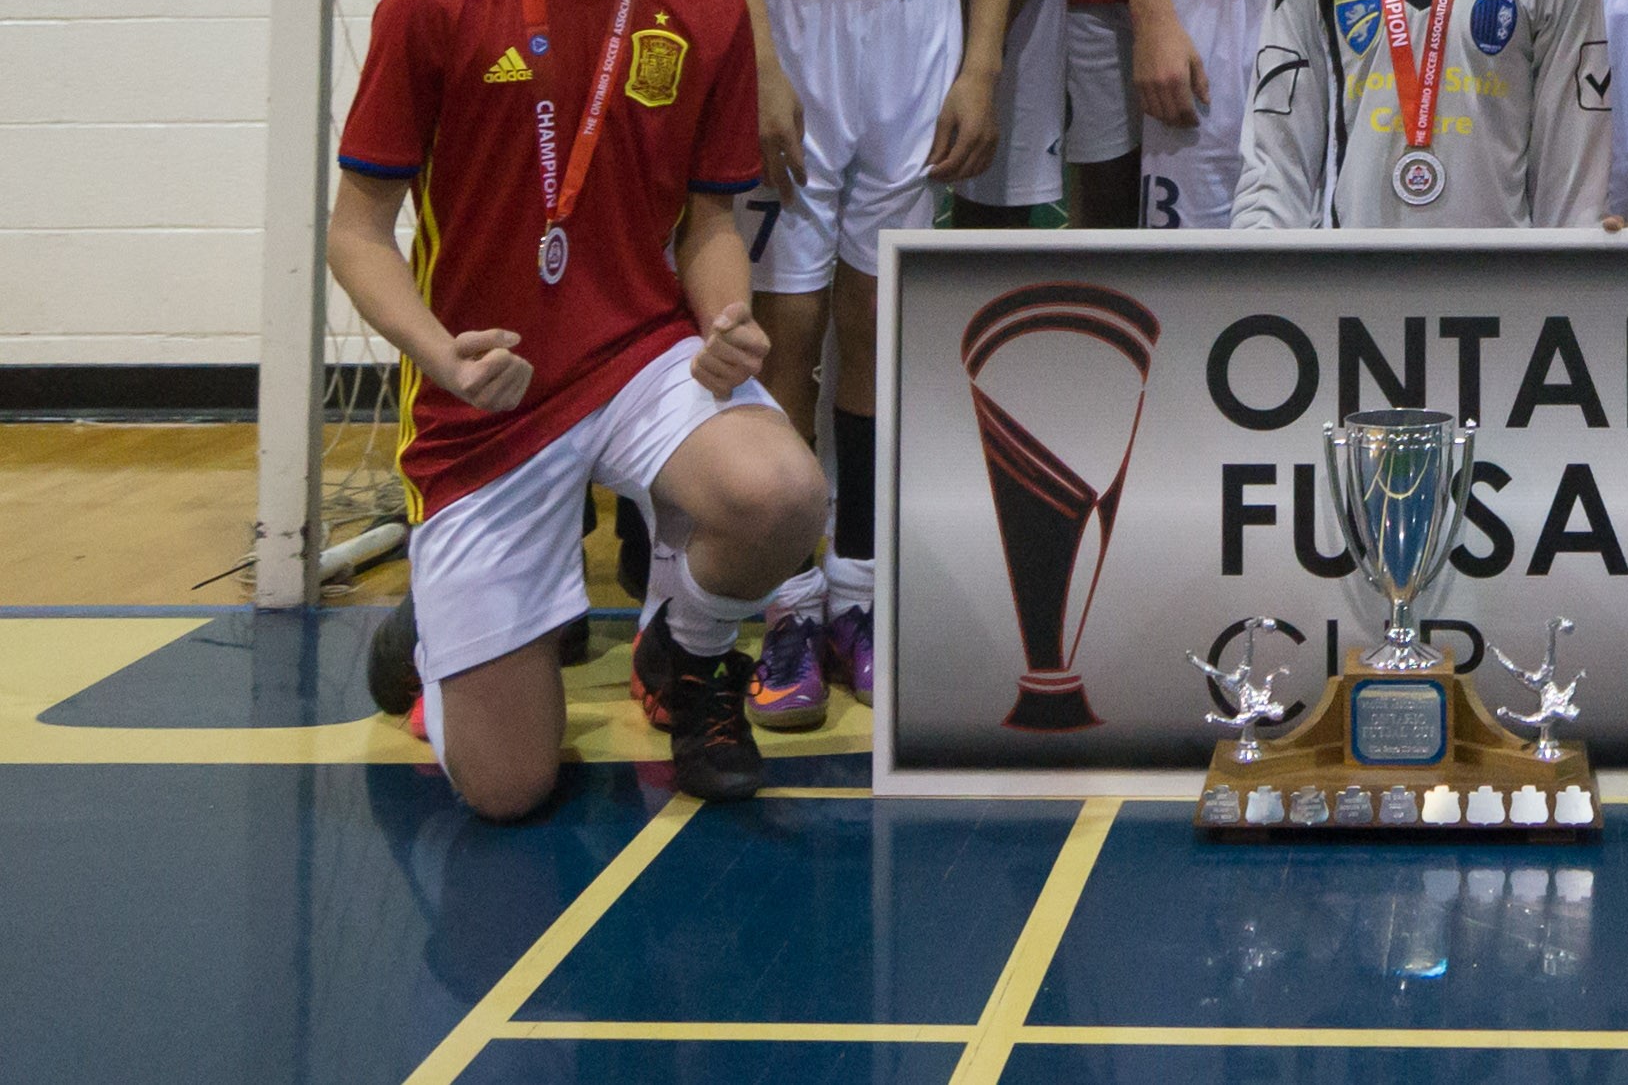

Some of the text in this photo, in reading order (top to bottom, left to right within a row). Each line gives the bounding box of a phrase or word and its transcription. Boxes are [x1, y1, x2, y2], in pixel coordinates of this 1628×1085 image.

[483, 69, 533, 83] adidas
[583, 118, 597, 135] THE
[603, 36, 620, 72] SOCCER
[1424, 49, 1438, 86] SOCCER
[1419, 88, 1432, 129] ONTARIO
[535, 100, 558, 209] CHAMPION
[1415, 130, 1426, 146] THE
[1206, 617, 1486, 727] CP
